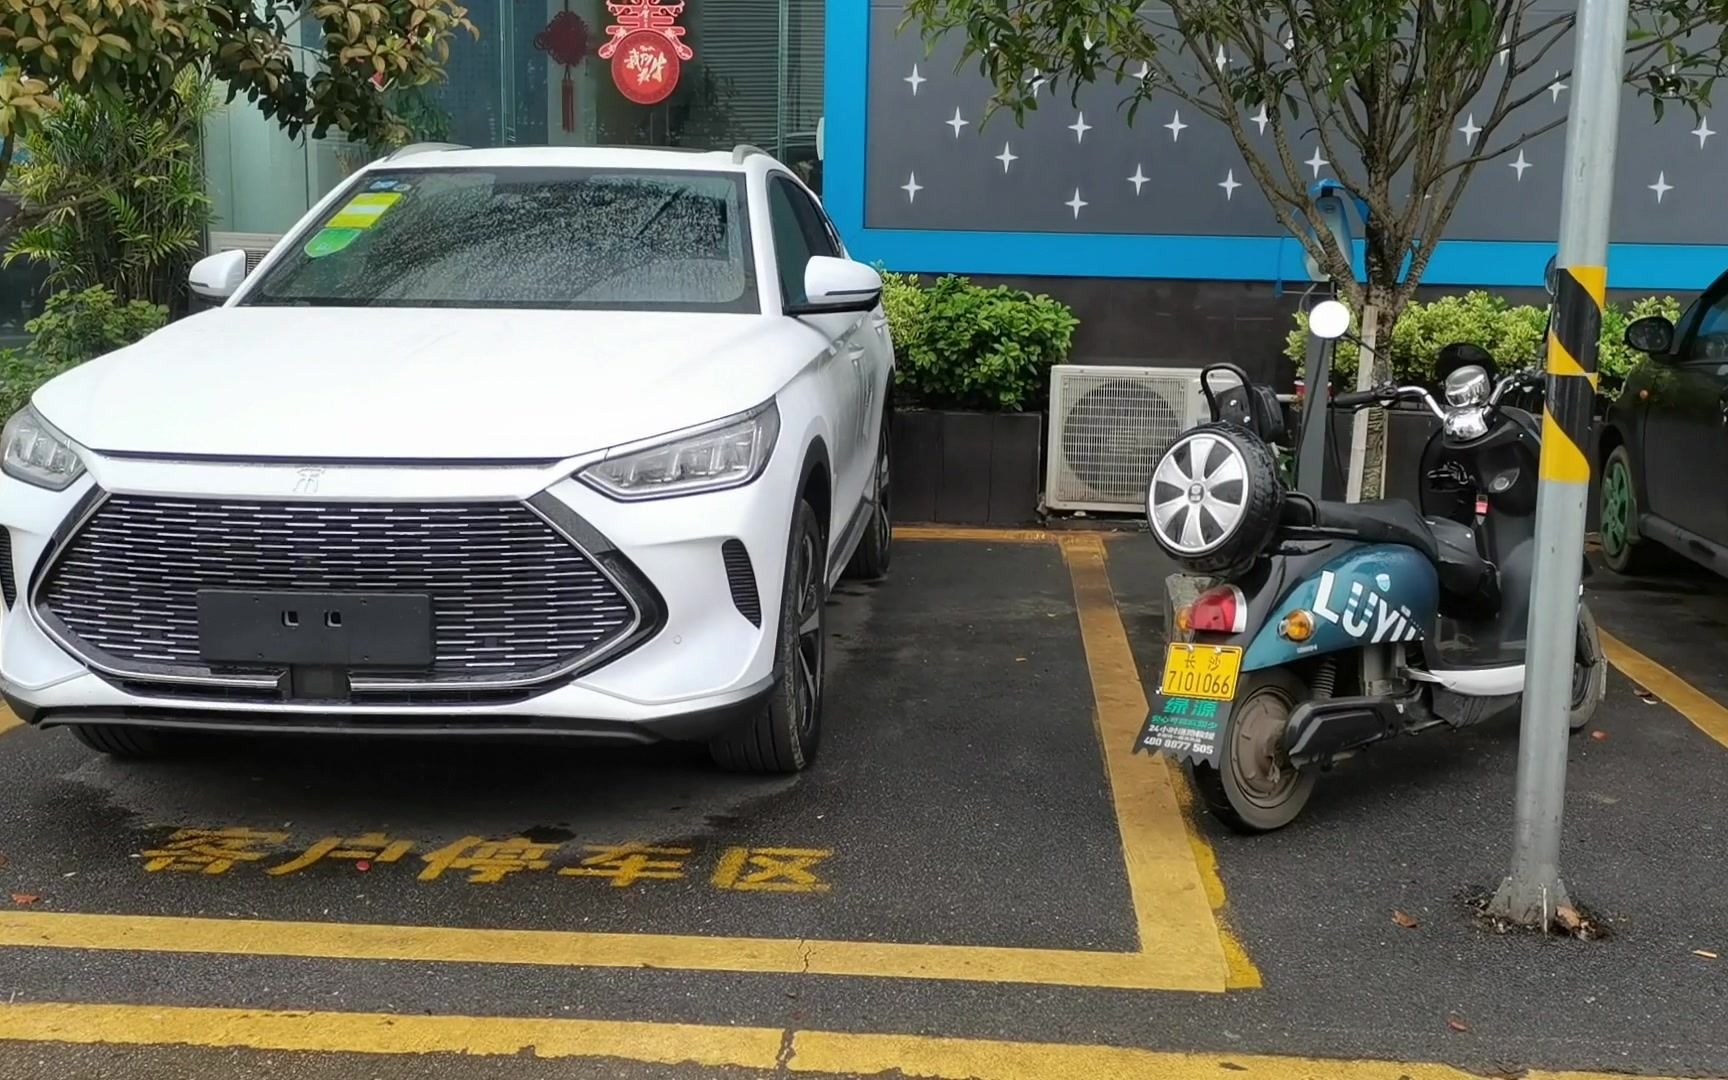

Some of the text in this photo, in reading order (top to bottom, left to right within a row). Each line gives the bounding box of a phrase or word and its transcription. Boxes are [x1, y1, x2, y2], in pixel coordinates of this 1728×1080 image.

[1184, 653, 1221, 672] 长沙
[1167, 670, 1231, 695] 7101066
[1143, 736, 1163, 747] 400
[1192, 743, 1215, 755] 505
[141, 826, 832, 893] 客户停车区
